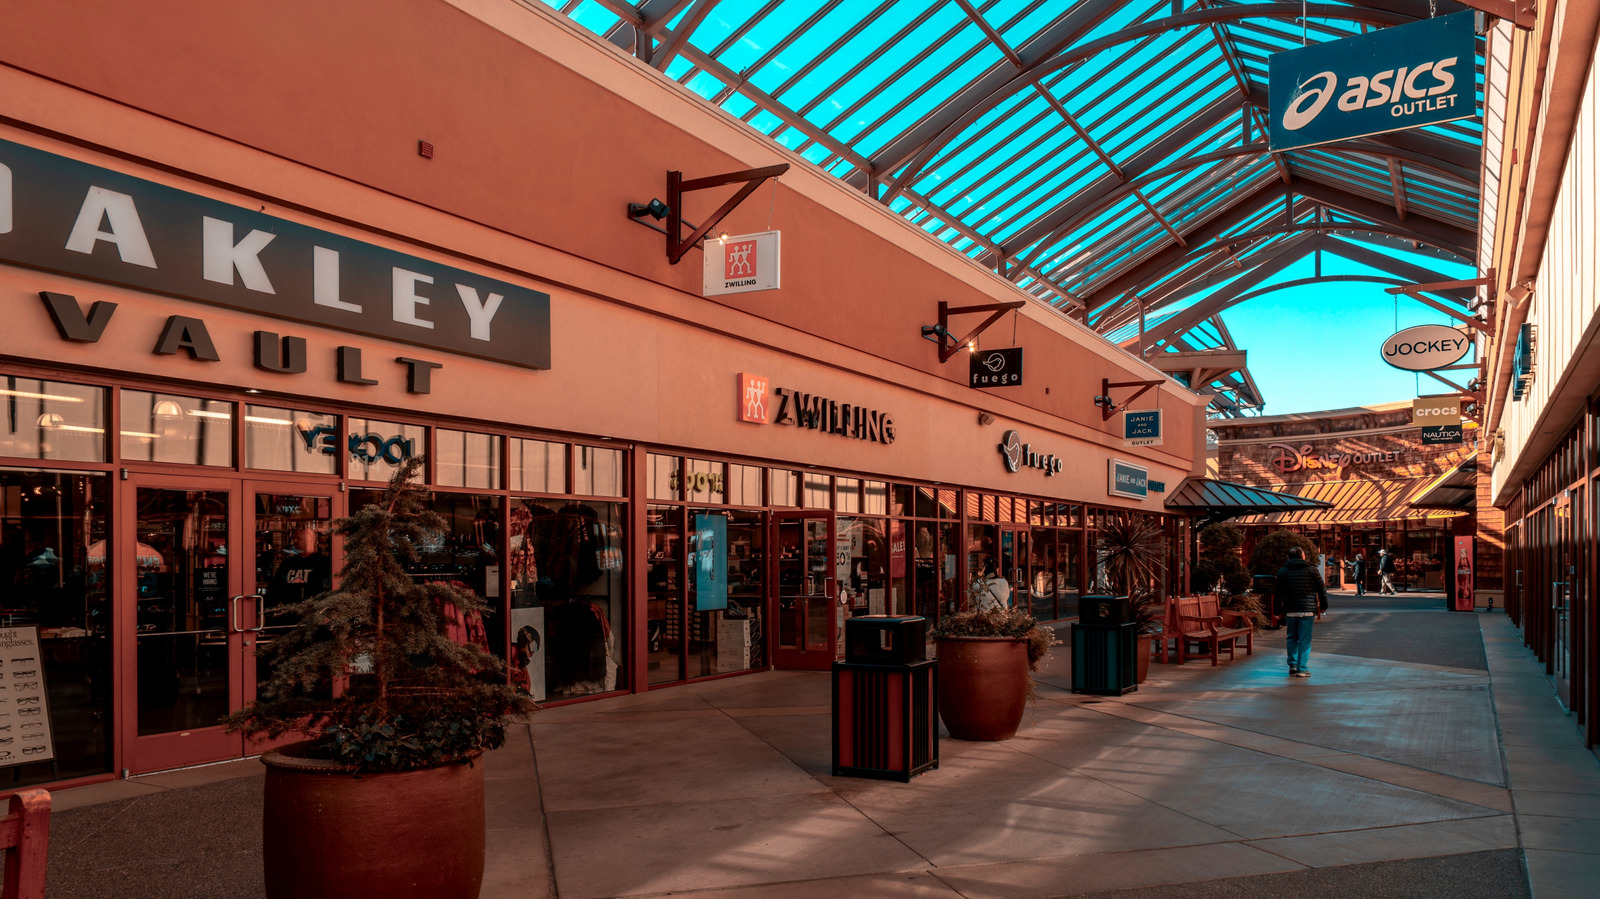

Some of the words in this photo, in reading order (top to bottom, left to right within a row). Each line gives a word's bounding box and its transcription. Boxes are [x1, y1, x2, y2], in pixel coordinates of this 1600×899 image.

[1391, 94, 1459, 118] OUTLET
[0, 162, 505, 342] AKLEY
[724, 279, 757, 288] ZWILLING
[39, 290, 443, 395] VAULT
[1385, 338, 1465, 357] JOCKEY
[973, 373, 1018, 384] fuego
[774, 387, 896, 445] ZWILLING
[1415, 406, 1458, 417] crocs
[1423, 430, 1461, 438] NAUTICA
[1022, 443, 1063, 477] fuego
[1353, 451, 1401, 465] OUTLET
[1117, 473, 1130, 485] JANIE
[202, 571, 217, 579] WE'RE
[202, 578, 218, 586] HIRING
[287, 568, 314, 584] CAT
